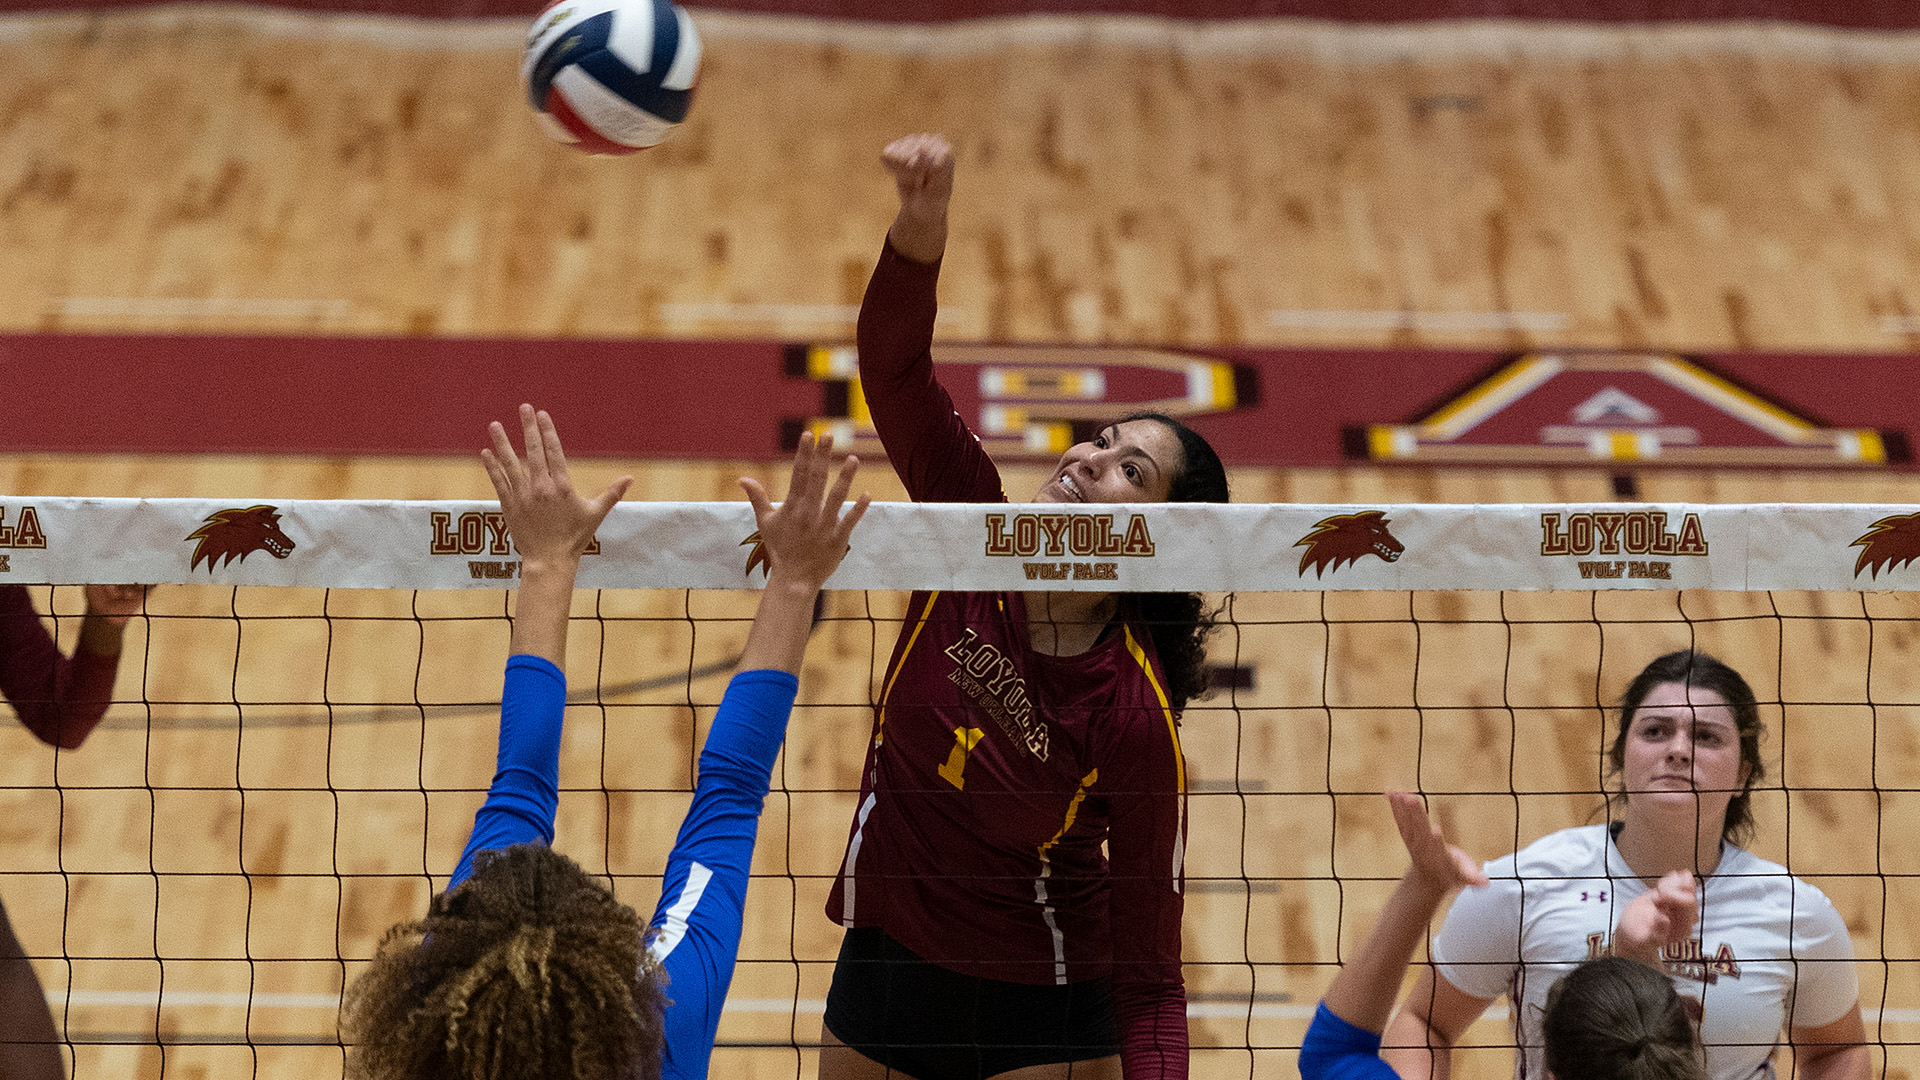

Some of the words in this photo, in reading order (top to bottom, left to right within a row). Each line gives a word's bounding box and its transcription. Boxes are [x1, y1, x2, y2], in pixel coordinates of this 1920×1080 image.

[431, 512, 601, 555] LOY
[985, 513, 1155, 557] LOYOLA
[1541, 512, 1708, 556] LOYOLA
[468, 561, 517, 579] WOLF
[1023, 562, 1071, 580] WOLF
[1073, 562, 1118, 580] PACK
[1578, 561, 1626, 579] WOLF
[1628, 561, 1672, 580] PACK
[944, 627, 1049, 762] LOYOLA
[947, 667, 985, 698] NEW
[938, 726, 985, 791] 1
[1587, 931, 1741, 979] LOLA
